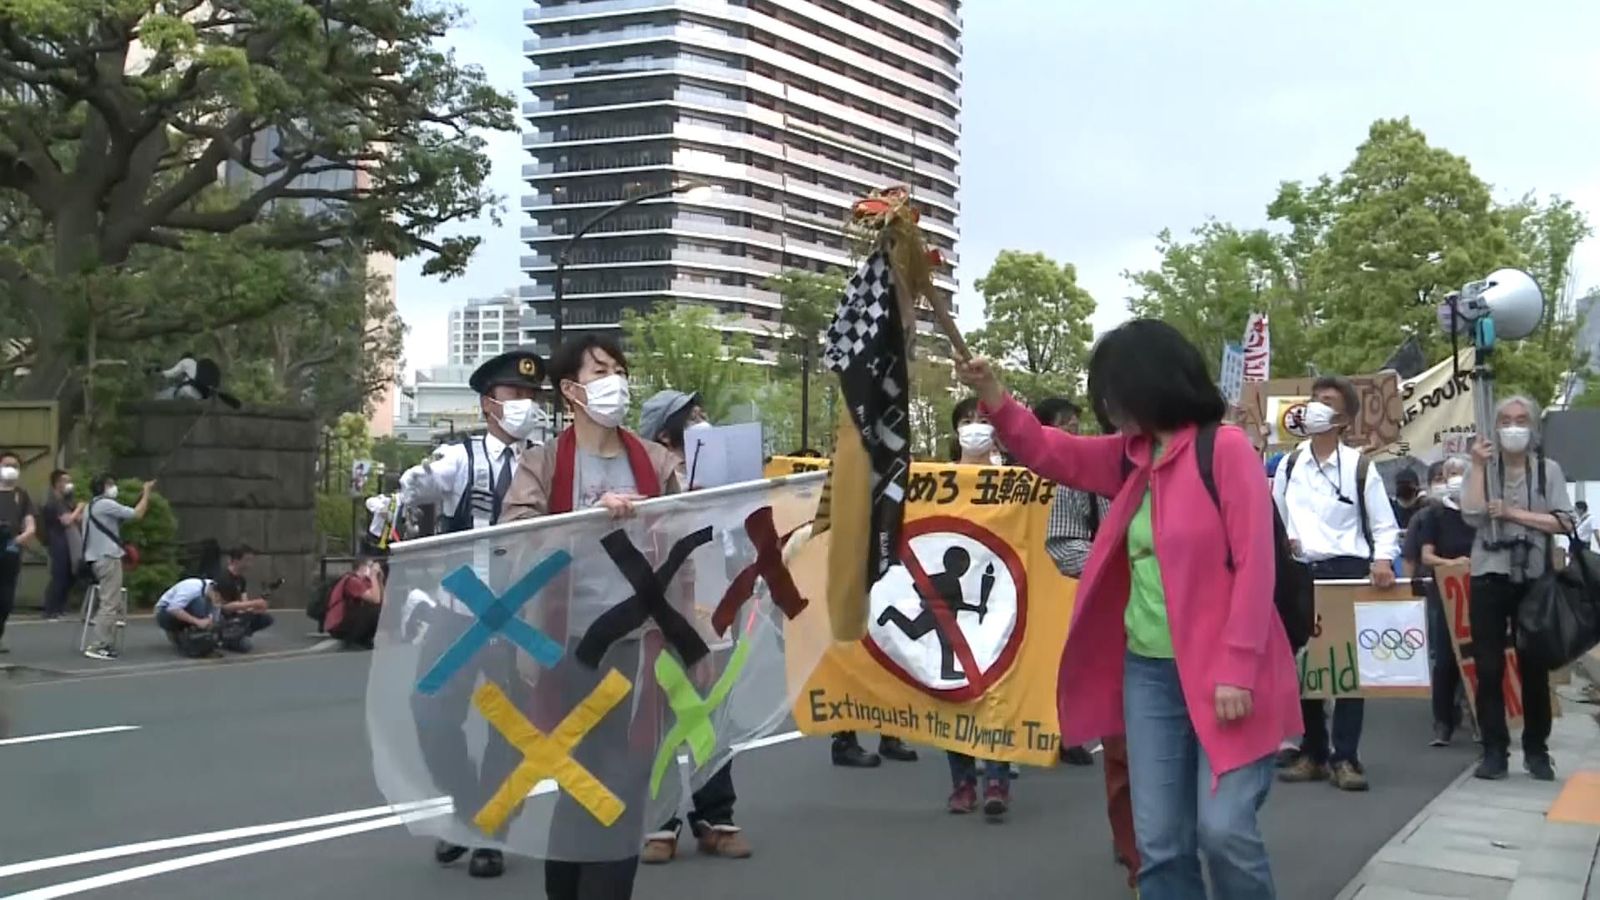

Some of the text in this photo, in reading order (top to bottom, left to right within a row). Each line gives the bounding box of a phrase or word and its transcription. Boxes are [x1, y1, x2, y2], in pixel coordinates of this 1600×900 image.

[970, 469, 1056, 505] 五輪は
[1301, 641, 1358, 695] orld
[810, 689, 919, 729] Extinguish
[925, 711, 951, 738] the
[956, 714, 1016, 753] Olympic
